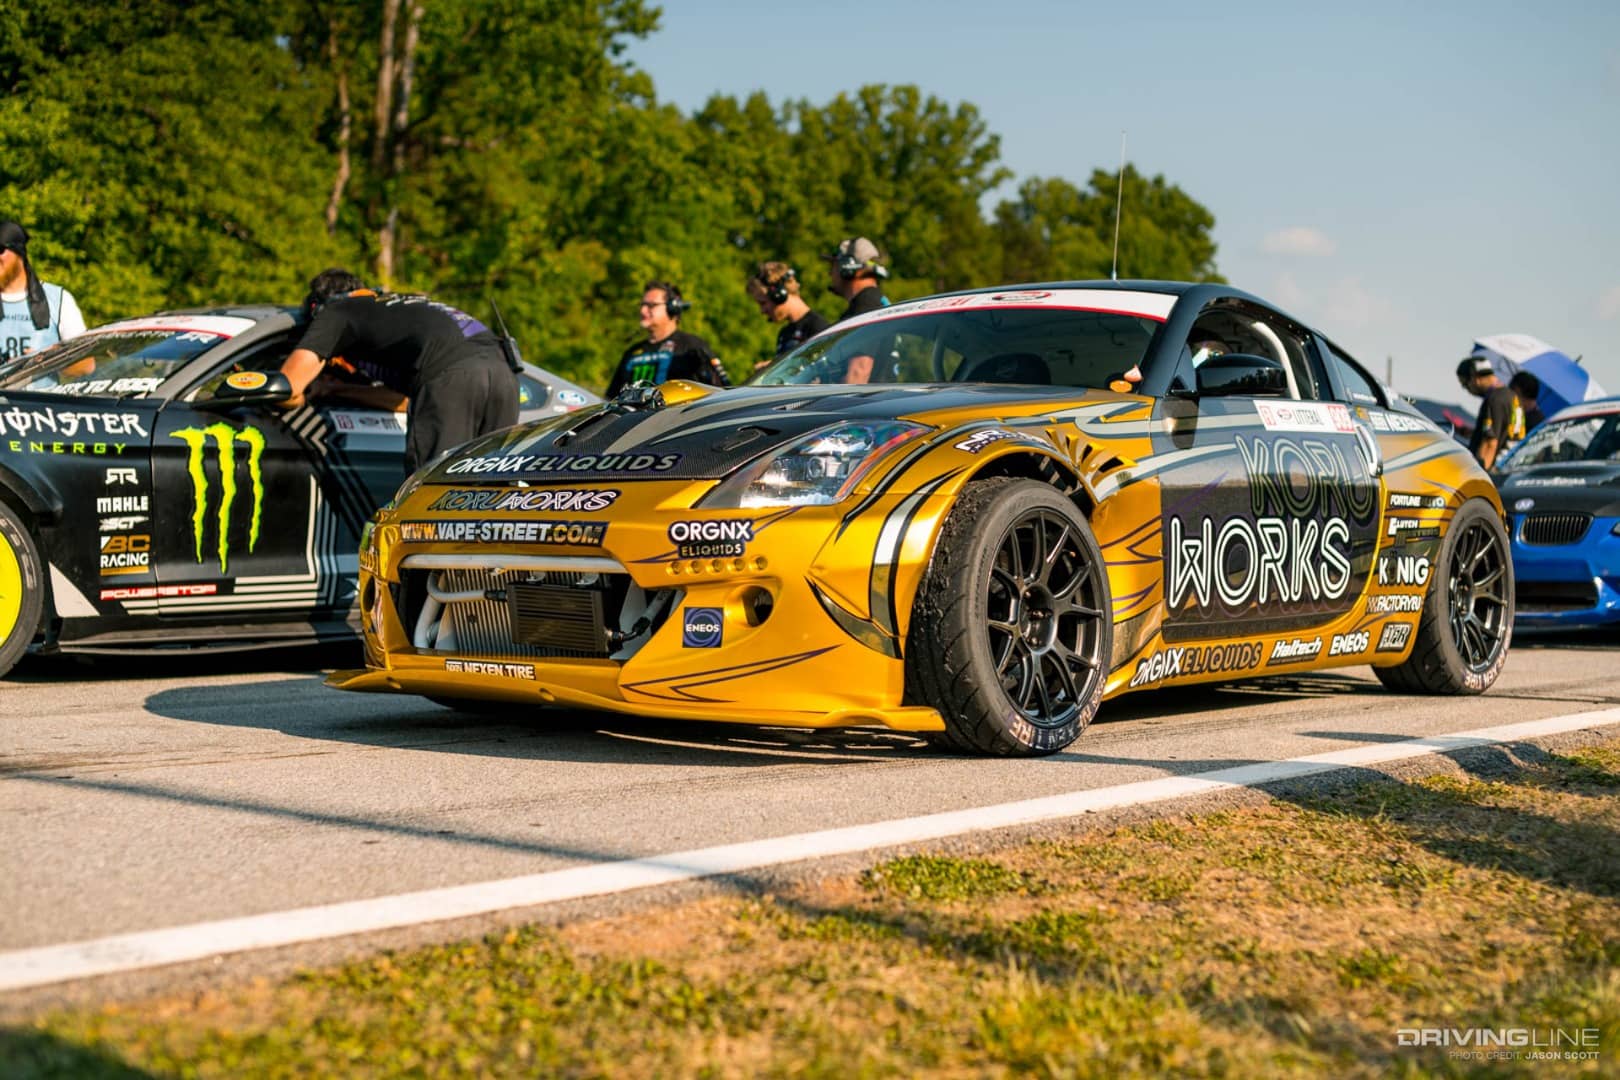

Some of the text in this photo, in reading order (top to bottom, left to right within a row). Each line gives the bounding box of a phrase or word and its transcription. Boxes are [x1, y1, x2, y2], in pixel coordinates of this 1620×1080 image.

[0, 406, 149, 438] ONSTER
[9, 440, 126, 455] ENERGY
[1236, 434, 1375, 520] KORU
[97, 495, 149, 514] MAHLE
[401, 522, 602, 545] WWW.VAPE-STREET.COM
[670, 521, 751, 542] ORGNX
[102, 535, 151, 554] BC
[681, 543, 742, 557] ELIQUIDS
[100, 552, 149, 569] RACING
[1169, 517, 1350, 608] WORKS
[685, 623, 720, 633] ENEOS
[1270, 637, 1323, 659] Haltech
[1329, 632, 1370, 656] ENEOS
[463, 661, 503, 678] NEXEN
[504, 664, 535, 680] TIRE
